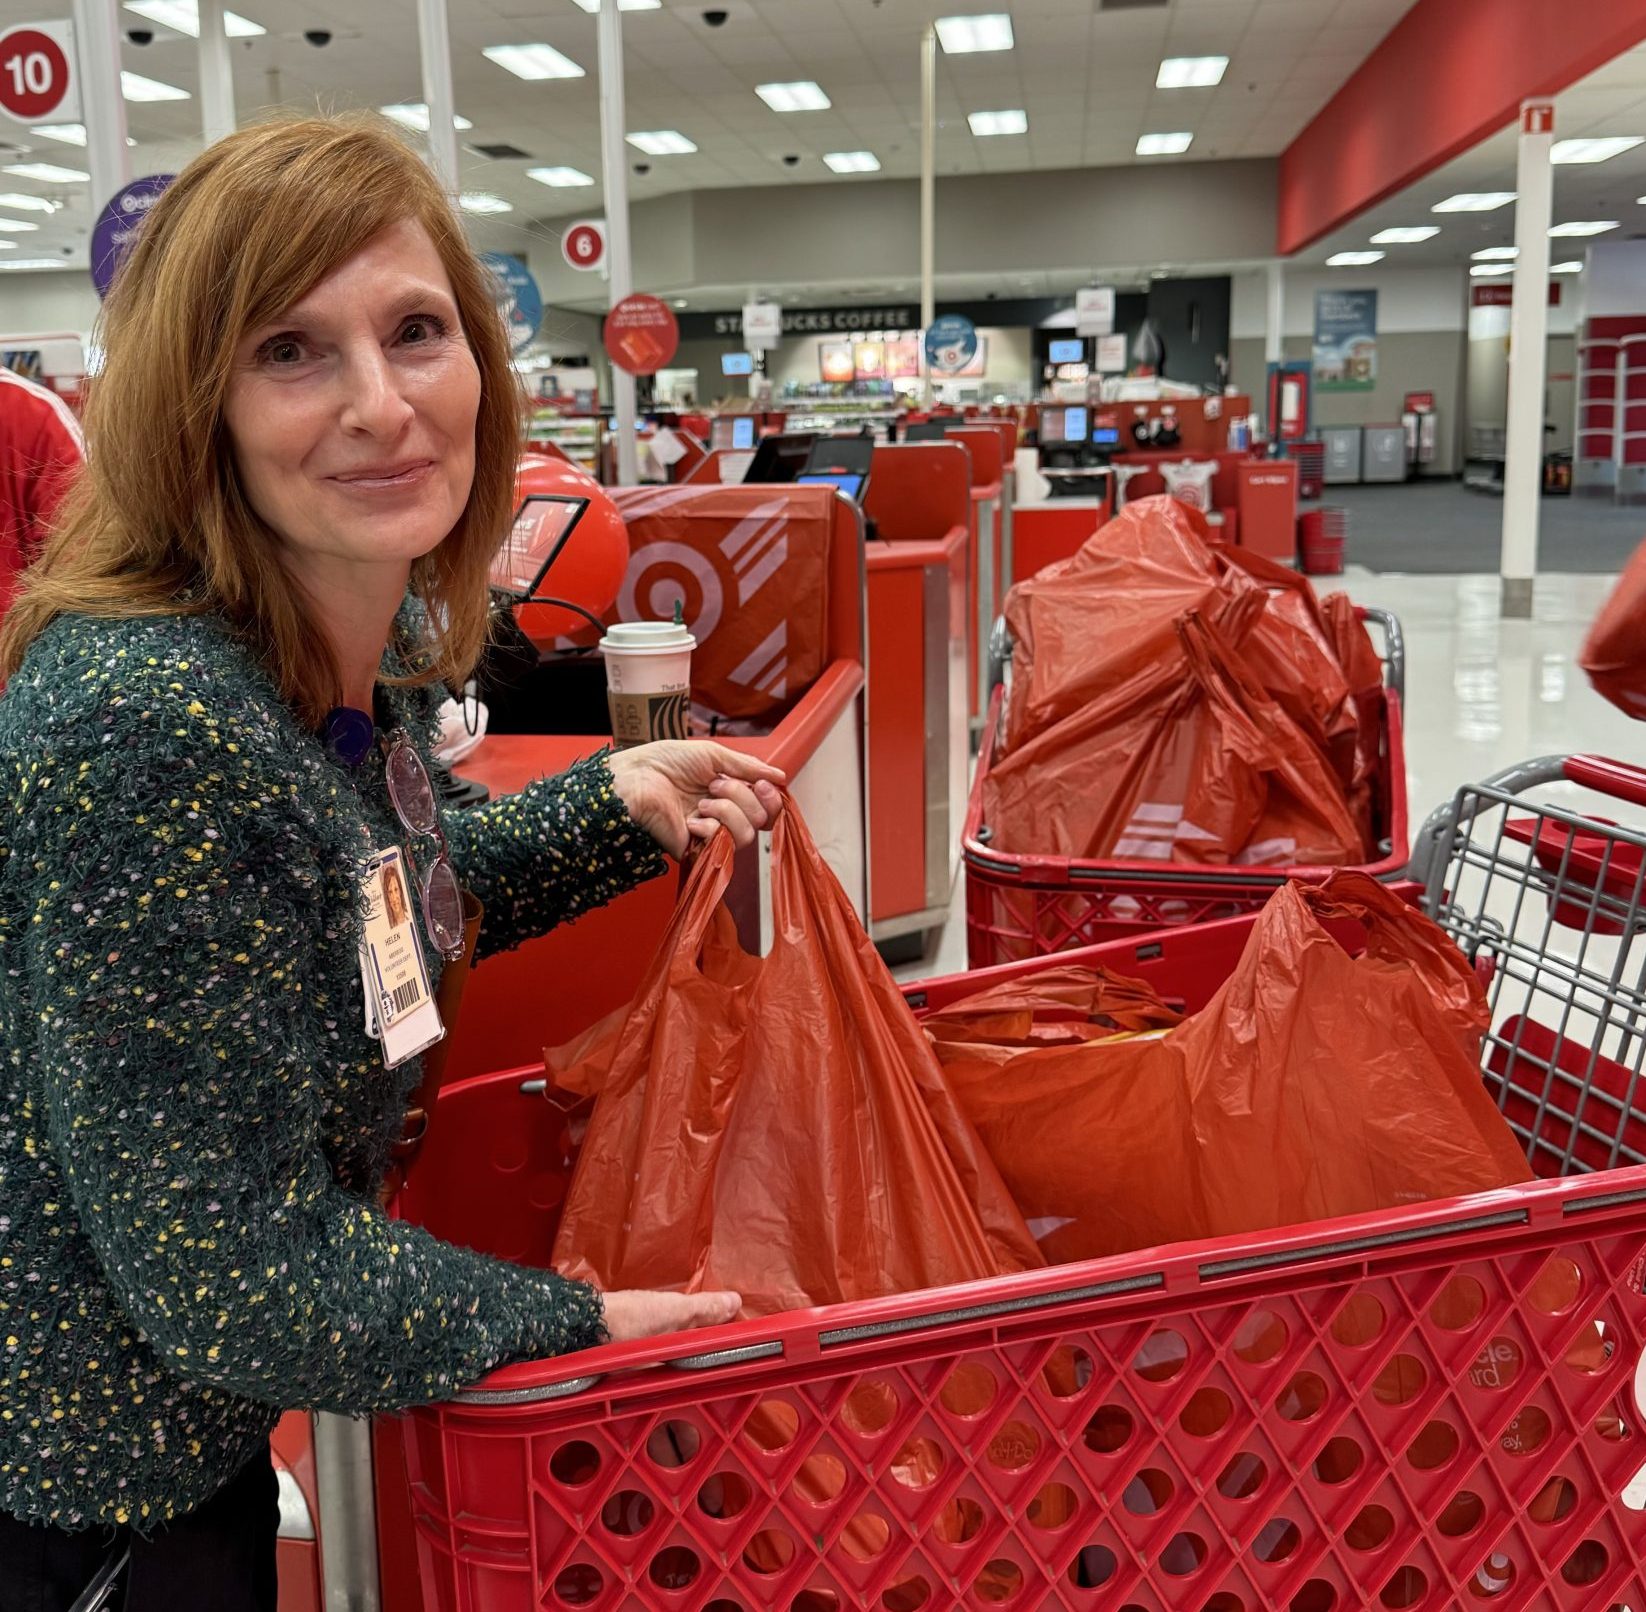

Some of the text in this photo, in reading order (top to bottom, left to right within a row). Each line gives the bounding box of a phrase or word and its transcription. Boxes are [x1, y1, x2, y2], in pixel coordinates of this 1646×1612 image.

[4, 51, 53, 96] 10
[576, 234, 593, 257] 6
[715, 312, 833, 334] STUCKS
[834, 309, 910, 329] COFFEE
[384, 932, 401, 947] HELEN
